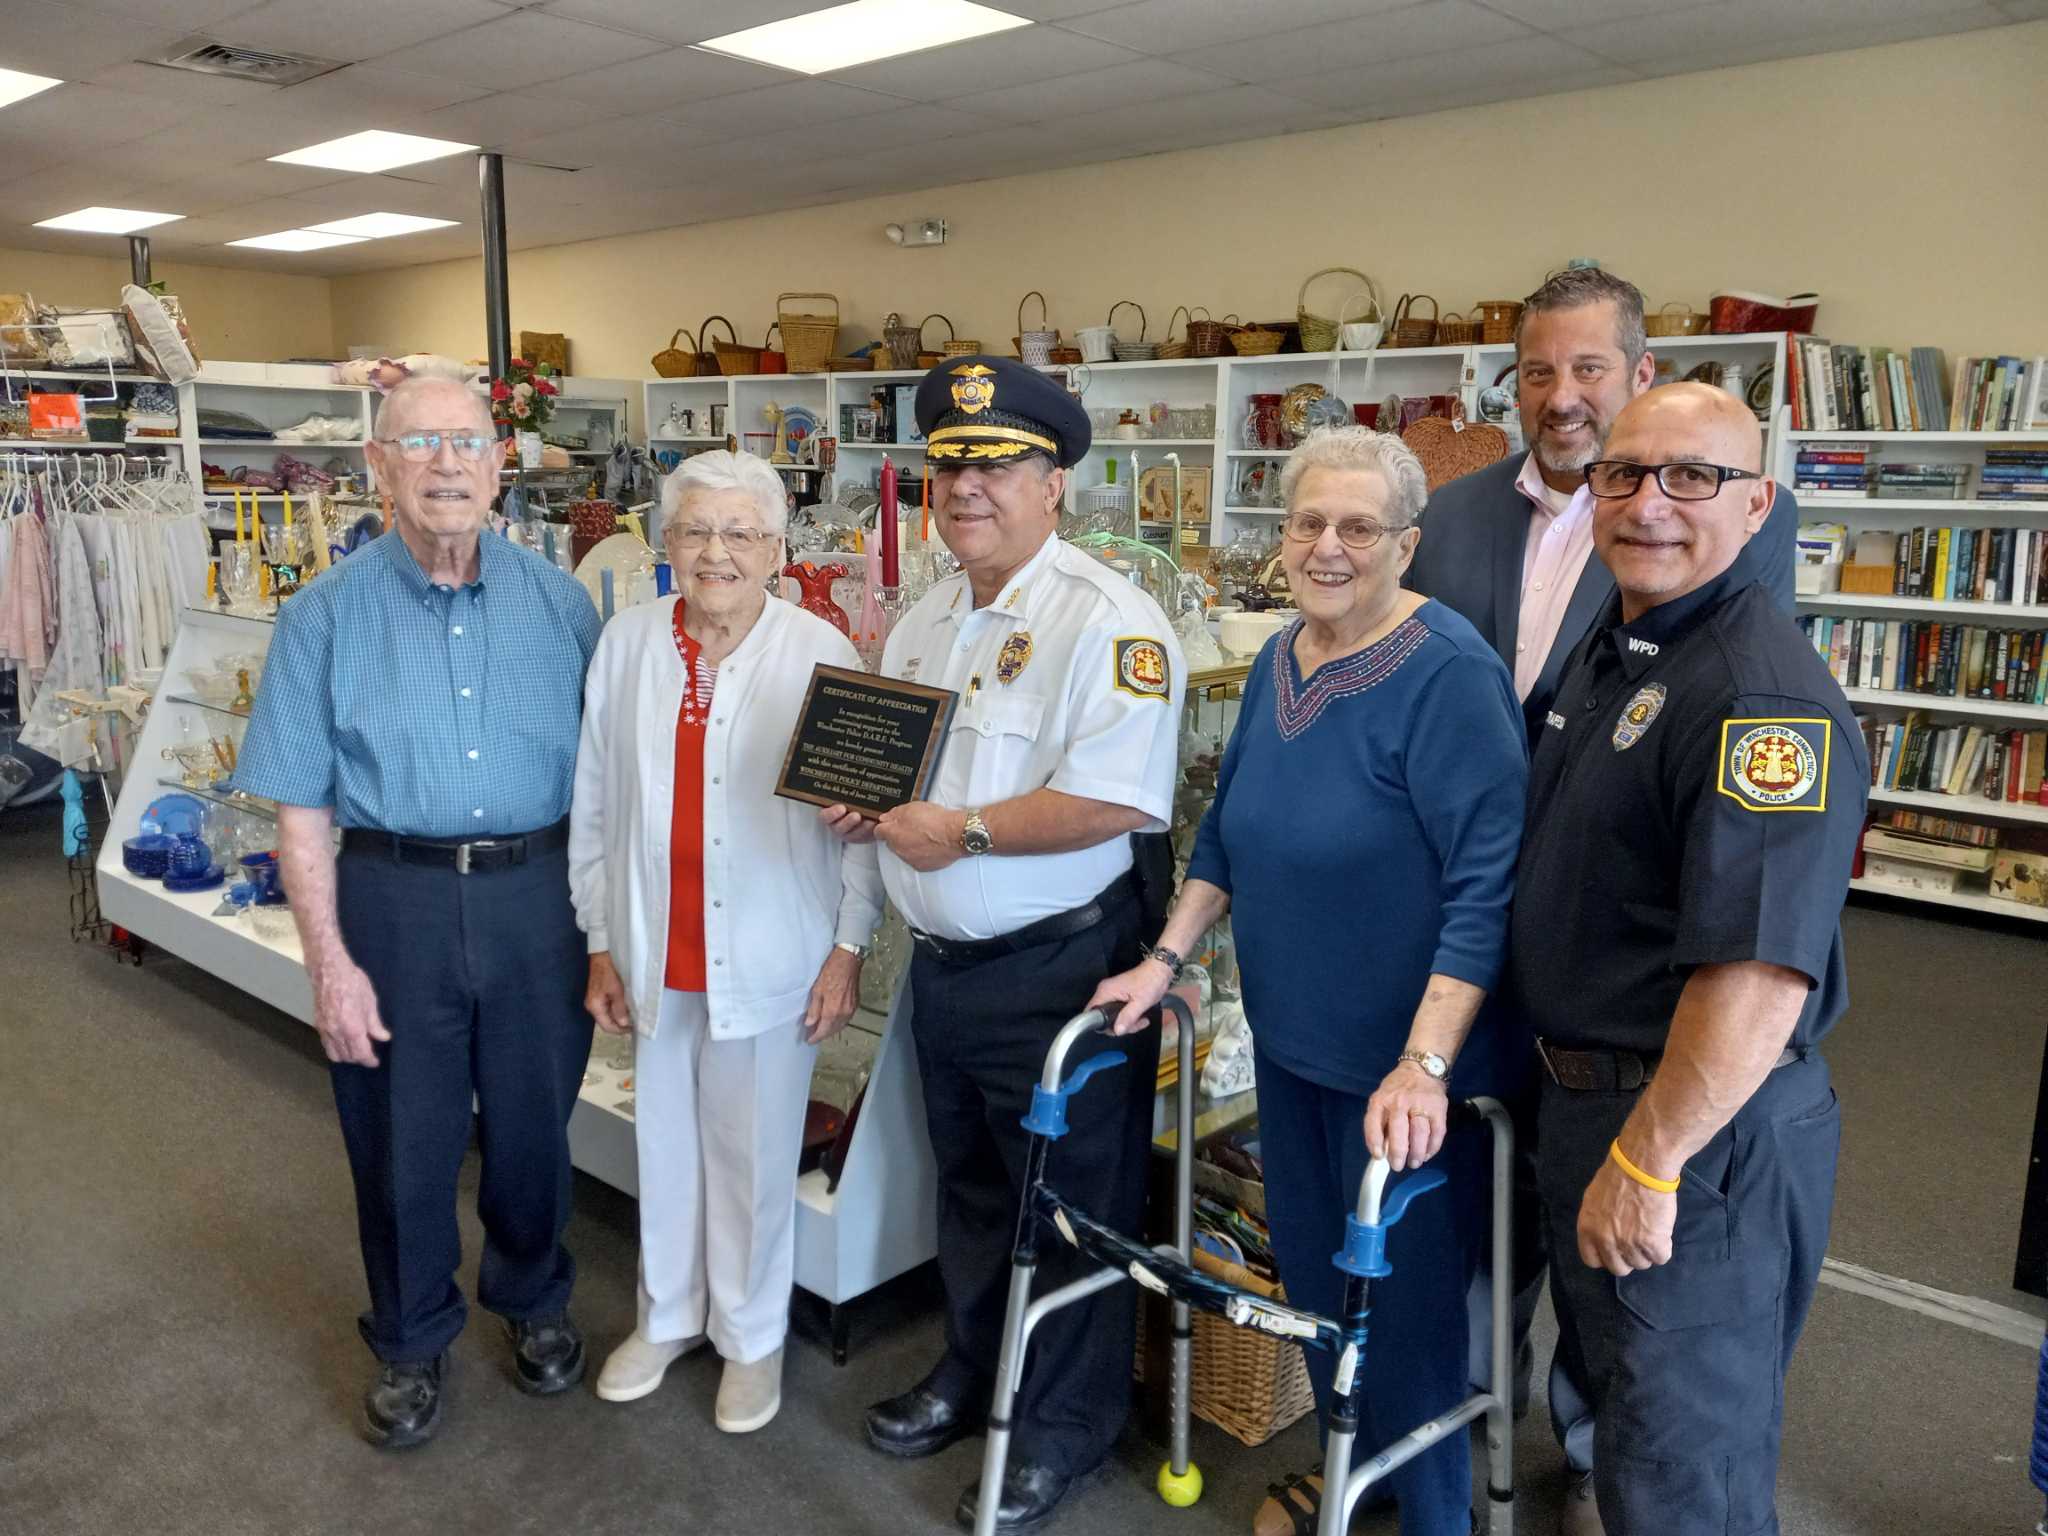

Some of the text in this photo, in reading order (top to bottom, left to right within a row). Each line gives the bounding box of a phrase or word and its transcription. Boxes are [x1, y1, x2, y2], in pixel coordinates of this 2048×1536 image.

[1142, 530, 1169, 539] Cuisinart
[1629, 637, 1660, 656] WPD
[823, 687, 866, 701] CERTIFICATE
[876, 698, 928, 713] APPRECIATION
[816, 722, 845, 732] Winchester
[846, 728, 861, 737] Police
[1737, 743, 1745, 753] OF
[1792, 735, 1815, 781] CONNECTICUT
[839, 776, 860, 784] POLICE
[861, 782, 901, 794] DEPARTMENT
[1760, 792, 1788, 801] POLICE
